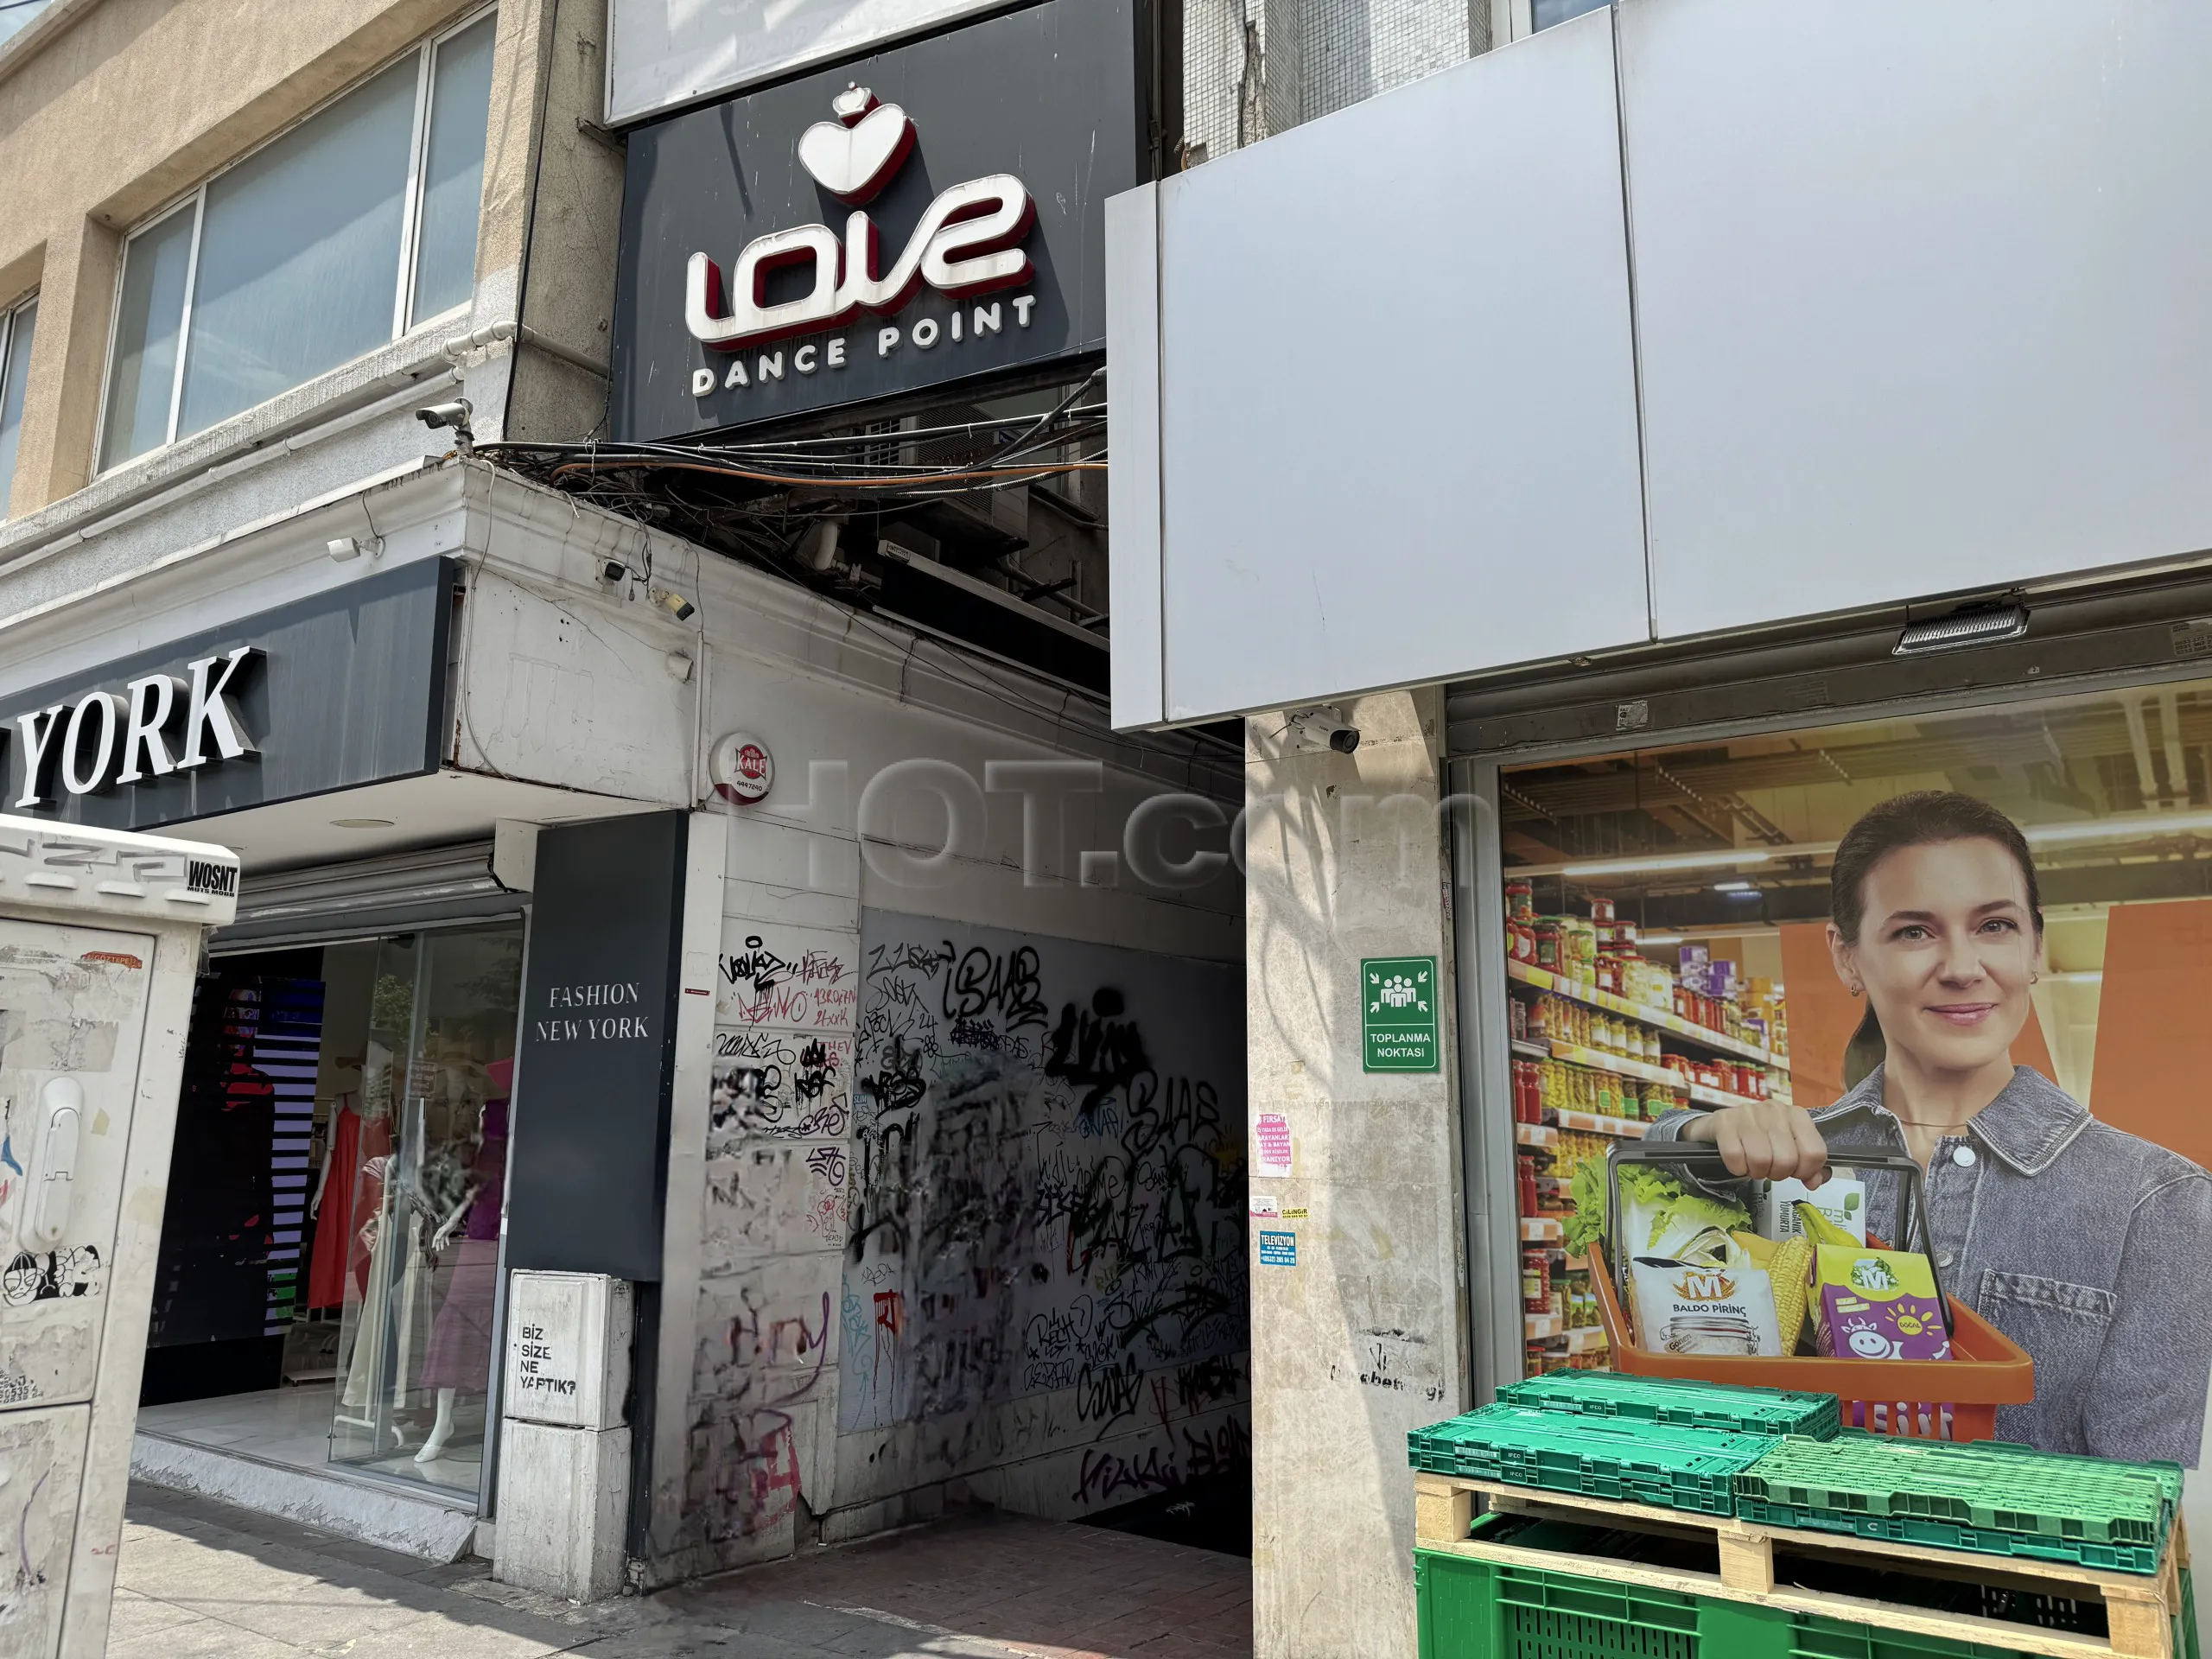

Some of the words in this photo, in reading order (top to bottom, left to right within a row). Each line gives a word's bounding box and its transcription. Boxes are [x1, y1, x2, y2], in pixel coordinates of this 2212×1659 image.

[692, 337, 848, 397] DANCE
[878, 295, 1036, 358] POINT
[15, 645, 259, 809] YORK
[736, 751, 766, 776] KALE
[188, 860, 238, 893] WOSNT
[550, 982, 640, 1008] FASHION
[535, 1020, 582, 1042] NEW
[588, 1017, 649, 1039] YORK
[1370, 1033, 1431, 1044] TOPLANMA
[1376, 1047, 1425, 1058] NOKTASI
[853, 1094, 867, 1103] SLIM
[1779, 1200, 1791, 1233] YUMURTA
[1261, 1233, 1294, 1247] TELEVİZYON
[1673, 1304, 1709, 1313] BALDO
[1712, 1303, 1746, 1317] PİRİNÇ
[522, 1324, 544, 1341] BİZ
[1669, 1333, 1692, 1351] Gönen
[521, 1341, 552, 1360] SİZE
[520, 1360, 539, 1374] NE
[520, 1376, 576, 1395] YAPTIK?
